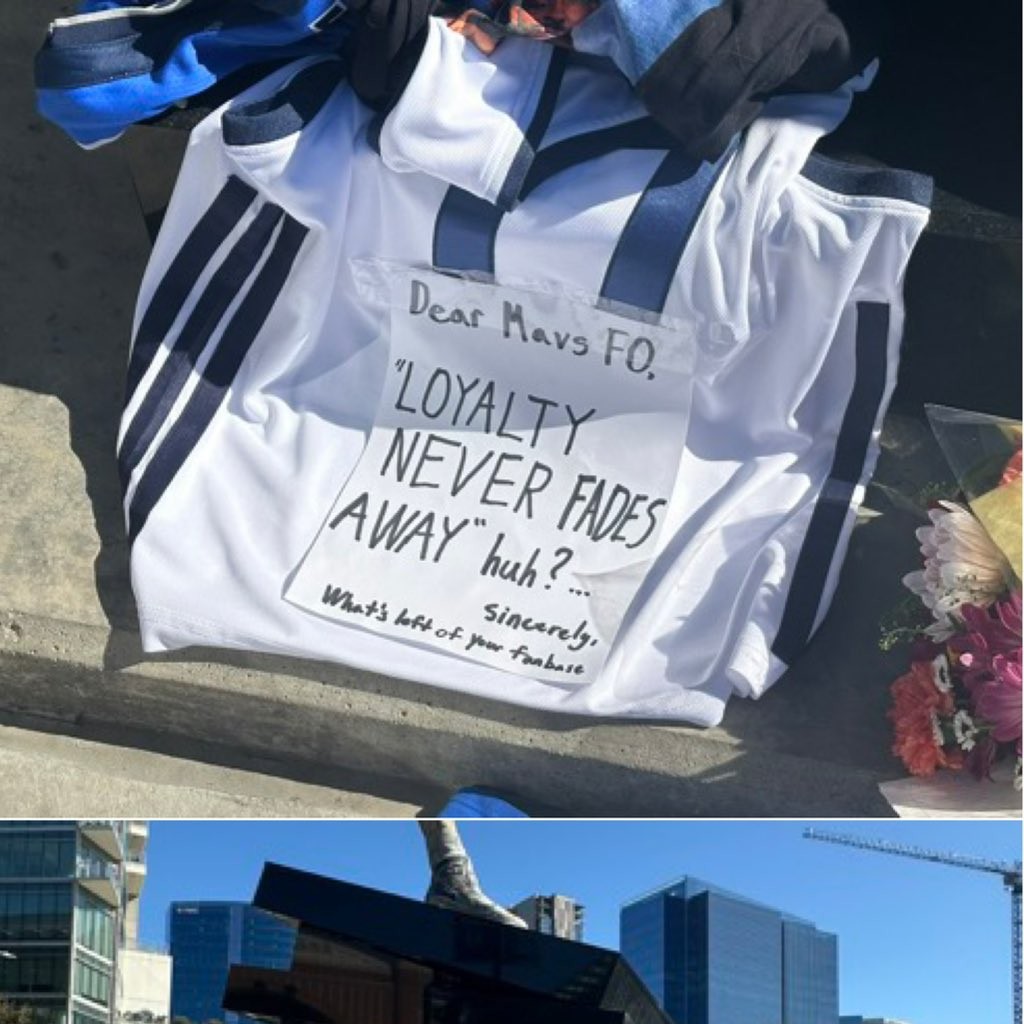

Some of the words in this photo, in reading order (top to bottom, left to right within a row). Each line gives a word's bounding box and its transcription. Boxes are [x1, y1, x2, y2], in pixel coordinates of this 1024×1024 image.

[409, 280, 485, 328] Dear
[502, 301, 589, 357] Mavs
[393, 358, 597, 456] "LOYALTY
[328, 492, 487, 563] AWAY"
[380, 428, 553, 520] NEVER
[557, 474, 667, 550] FADES
[321, 584, 388, 623] What's
[394, 608, 434, 634] left
[434, 626, 464, 641] of
[470, 629, 504, 658] your
[509, 645, 585, 677] fanbase
